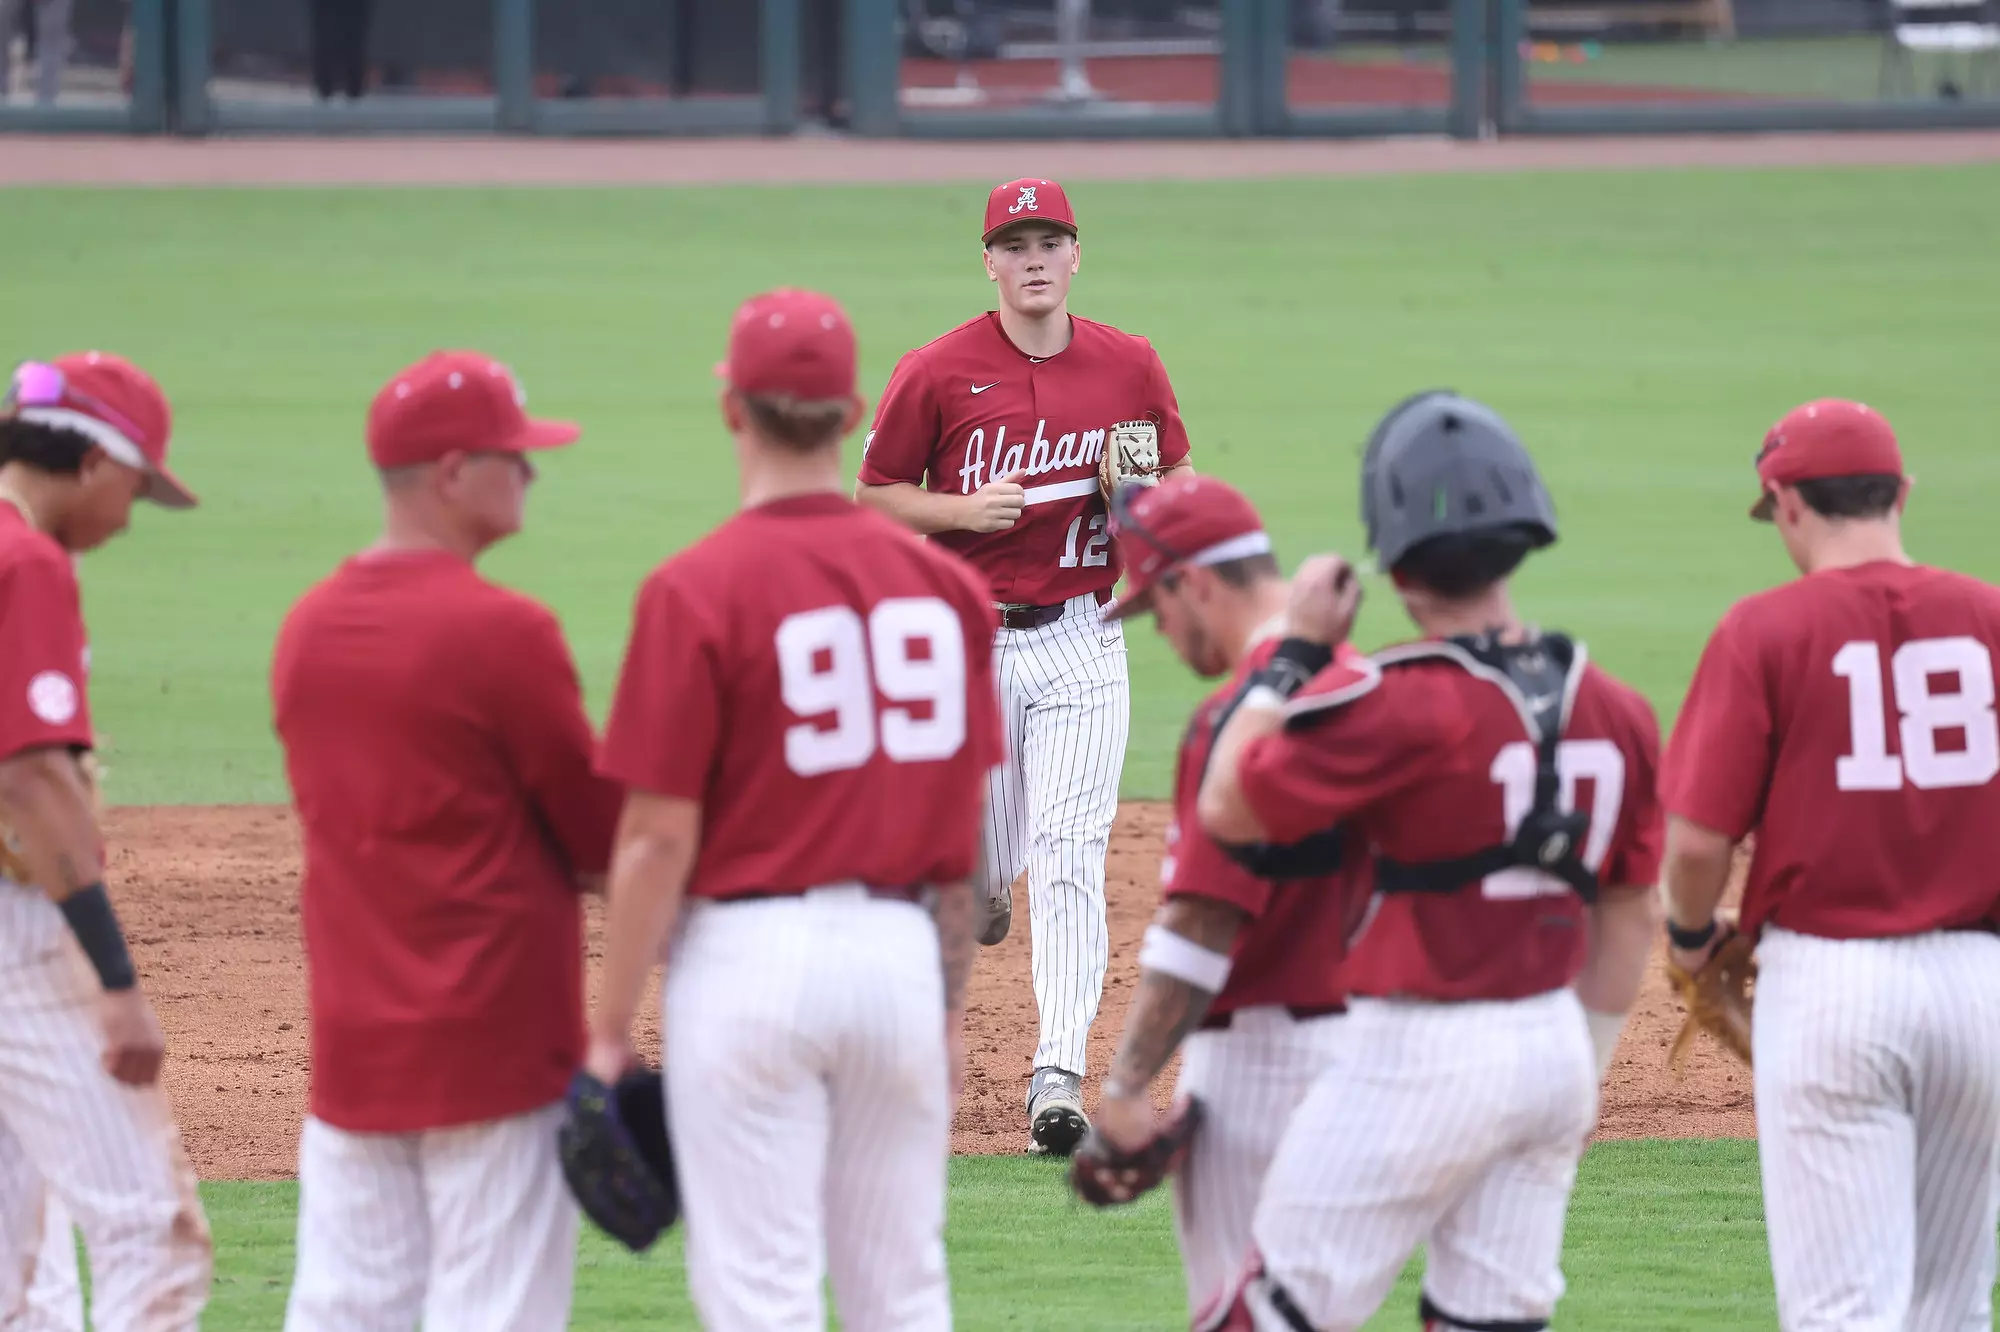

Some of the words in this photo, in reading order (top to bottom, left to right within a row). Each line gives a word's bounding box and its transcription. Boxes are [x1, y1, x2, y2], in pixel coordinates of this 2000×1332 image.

[1008, 186, 1038, 214] A
[958, 419, 1106, 495] Alabam
[1059, 513, 1109, 568] 12
[774, 596, 967, 777] 99
[1832, 635, 2000, 791] 18
